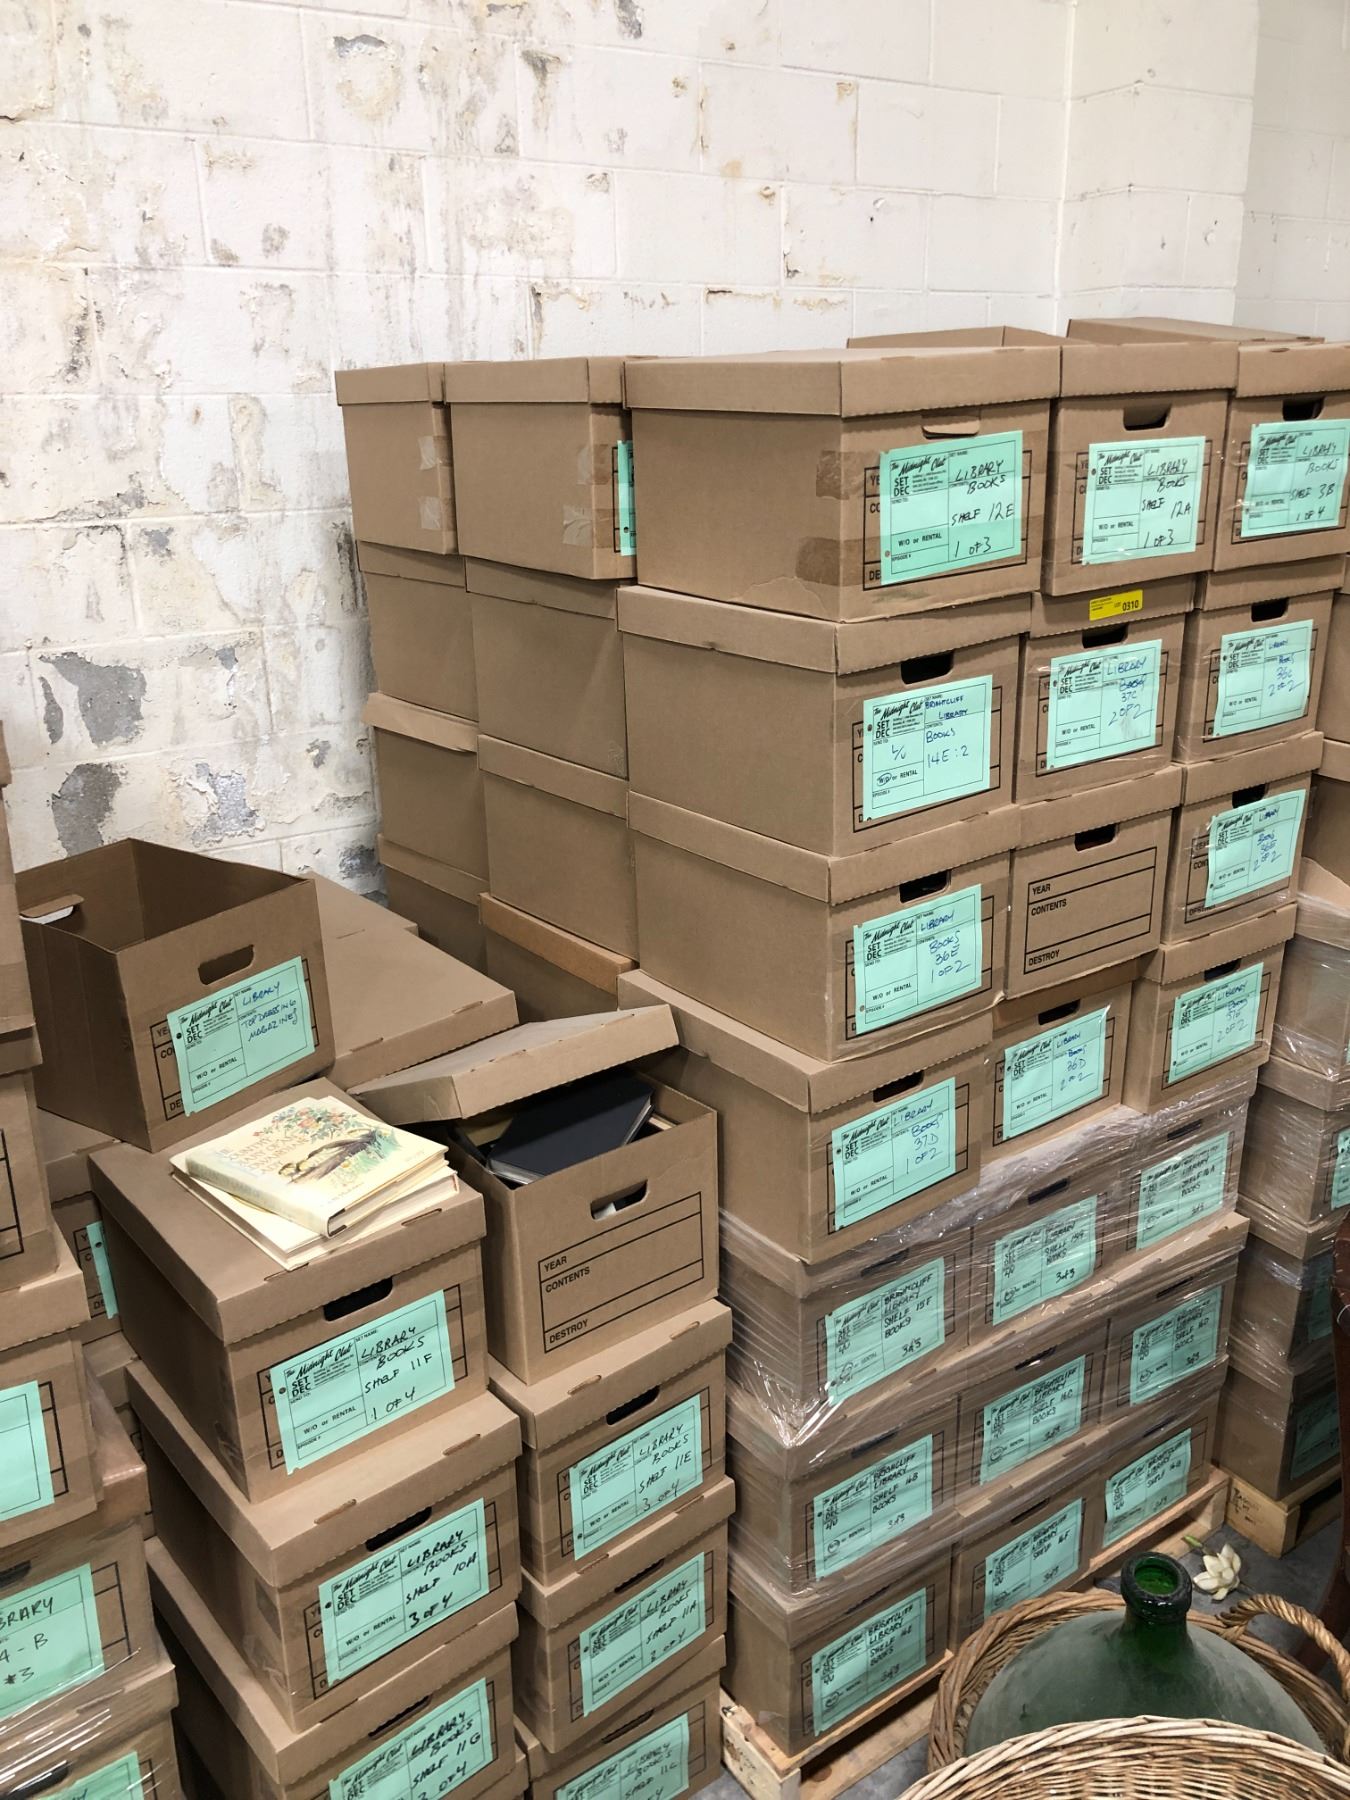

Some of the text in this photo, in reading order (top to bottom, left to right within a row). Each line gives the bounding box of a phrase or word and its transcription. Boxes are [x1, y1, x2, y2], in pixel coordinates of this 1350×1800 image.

[1303, 442, 1336, 456] LIBRARY
[899, 456, 930, 476] Midnight
[931, 458, 945, 471] Club
[956, 460, 1003, 481] LIBRARY
[1101, 467, 1112, 475] SET
[1148, 458, 1187, 476] LIBRARY
[895, 477, 909, 487] SET
[967, 475, 1006, 494] BOOKS
[1099, 476, 1111, 484] DEC
[1157, 475, 1189, 492] BOOKS
[894, 487, 909, 496] DEC
[1318, 483, 1335, 499] 3B
[952, 502, 1014, 526] SHELF 12E
[1170, 501, 1191, 519] 12A
[1318, 506, 1325, 519] 4
[1144, 531, 1149, 548] 1
[1168, 529, 1173, 546] 3
[955, 541, 959, 557] 1
[984, 537, 991, 552] 3
[1123, 600, 1139, 611] 0310
[881, 701, 910, 720] Midnight
[910, 702, 923, 714] Club
[939, 709, 968, 719] LIBRARY
[1133, 704, 1152, 719] 2
[877, 720, 889, 729] SET
[876, 729, 889, 739] DEC
[1032, 884, 1050, 894] YEAR
[1032, 899, 1066, 915] CONTENTS
[921, 910, 954, 931] LIBRARY
[871, 921, 900, 943] Midnight
[900, 921, 913, 934] Club
[868, 942, 880, 952] SET
[930, 930, 960, 954] BOOKS
[867, 950, 881, 961] DEC
[1029, 950, 1059, 965] DESTROY
[955, 960, 971, 973] 2
[242, 982, 280, 1006] LIBRARY
[189, 1002, 218, 1026] Midnight
[219, 998, 232, 1013] Club
[186, 1024, 200, 1035] SET
[187, 1031, 202, 1043] DEC
[219, 1057, 237, 1068] RENTAL
[845, 1150, 858, 1159] DEC
[846, 1142, 858, 1151] SET
[931, 1148, 942, 1160] 2
[544, 1256, 567, 1272] YEAR
[546, 1267, 590, 1292] CONTENTS
[549, 1319, 588, 1344] DESTROY
[361, 1326, 415, 1359] LIBRARY
[296, 1349, 333, 1379] Midnight
[335, 1342, 352, 1362] Club
[376, 1336, 424, 1370] BOOKS
[292, 1376, 309, 1389] SET
[365, 1369, 399, 1393] SHELF
[292, 1383, 311, 1397] DEC
[373, 1387, 415, 1419] 1 OF 4
[332, 1406, 356, 1421] RENTAL
[640, 1424, 683, 1456] LIBRARY
[652, 1434, 688, 1464] BOOKS
[583, 1482, 598, 1493] DEC
[584, 1475, 596, 1485] SET
[642, 1498, 650, 1511] 3
[670, 1479, 679, 1497] 4
[407, 1530, 463, 1568] LIBRARY
[424, 1541, 468, 1576] BOOKS
[342, 1562, 379, 1594] Midnight
[379, 1555, 397, 1573] Club
[338, 1589, 353, 1601] SET
[338, 1597, 356, 1610] DEC
[409, 1613, 419, 1629] 3
[442, 1592, 452, 1608] 4
[0, 1597, 53, 1630] BRARY
[373, 1615, 396, 1630] RENTAL
[411, 1712, 465, 1757] LIBRARY
[457, 1761, 467, 1776] 4
